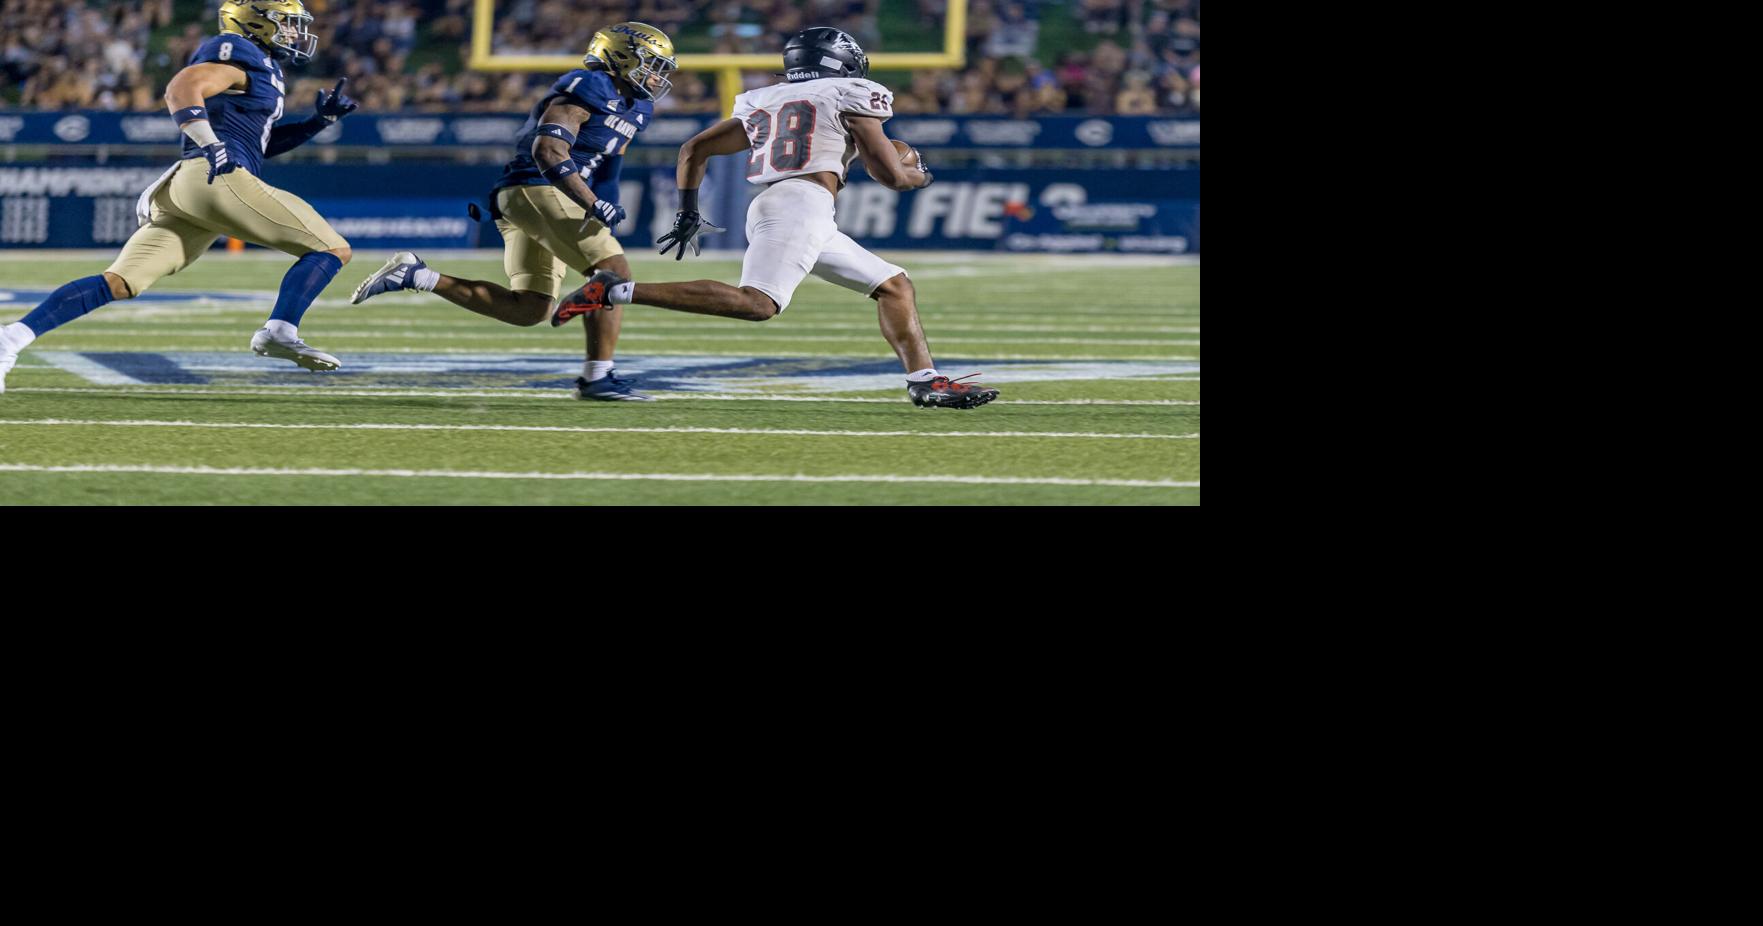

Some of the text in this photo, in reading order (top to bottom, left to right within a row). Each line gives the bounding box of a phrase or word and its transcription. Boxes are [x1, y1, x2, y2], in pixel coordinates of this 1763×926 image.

[218, 42, 233, 61] 8
[787, 71, 820, 81] Riddell
[565, 77, 583, 93] 1
[746, 100, 817, 178] 28
